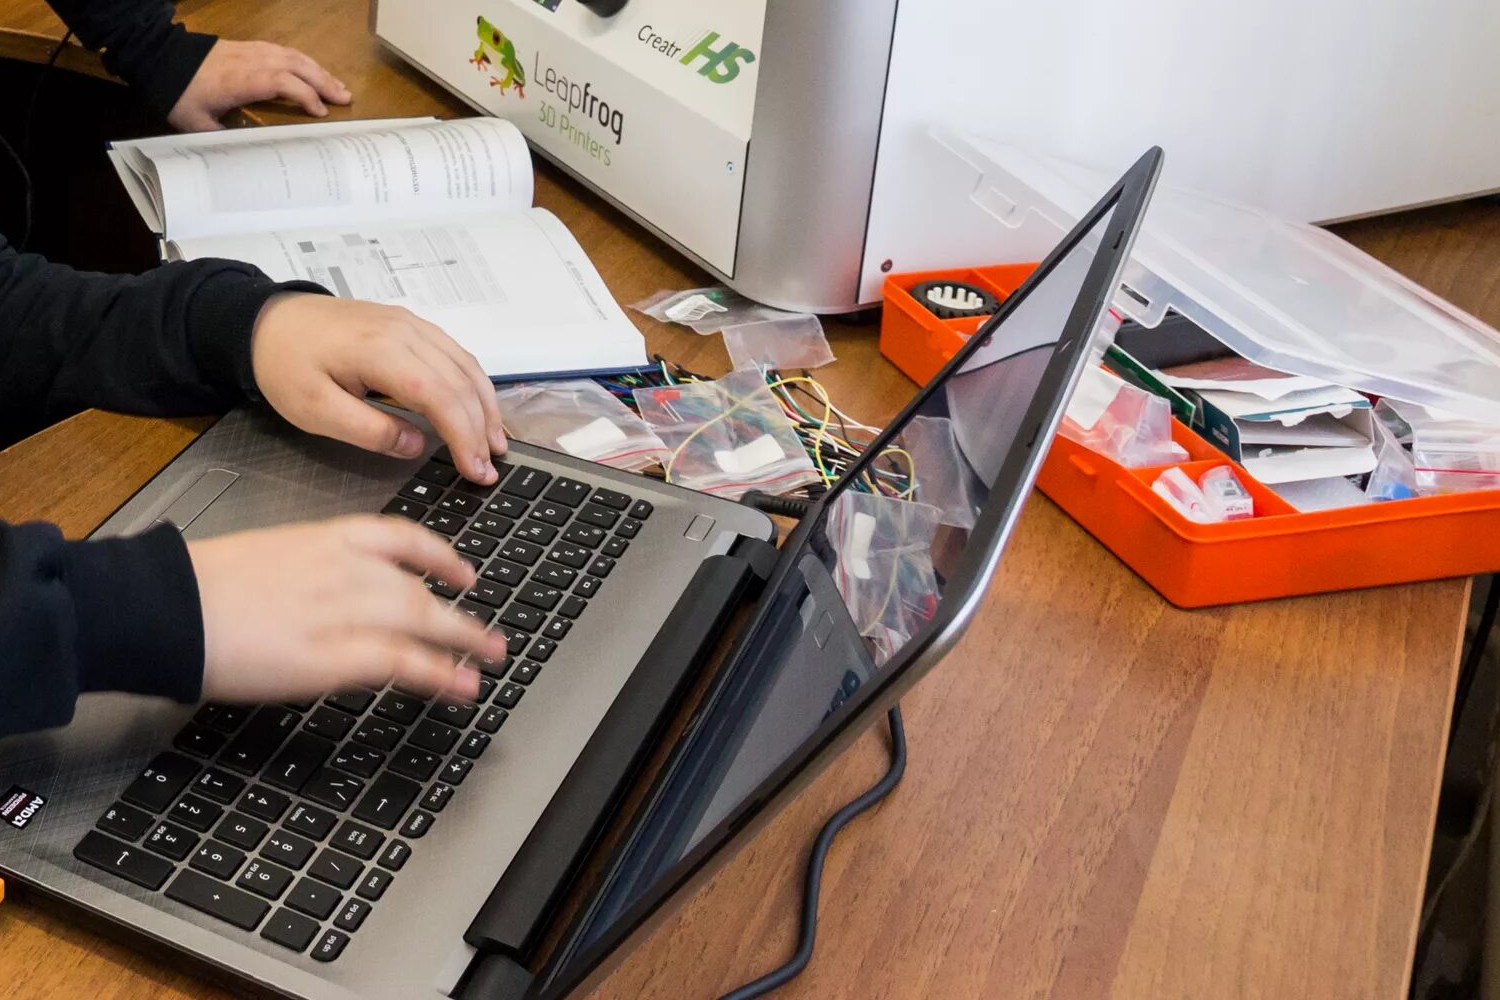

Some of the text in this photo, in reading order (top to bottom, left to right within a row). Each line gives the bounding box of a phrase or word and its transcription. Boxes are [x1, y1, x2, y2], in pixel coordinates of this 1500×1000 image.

[637, 24, 756, 84] Creatr HS
[533, 51, 624, 145] Leapfrog
[538, 100, 611, 167] 3D Printers
